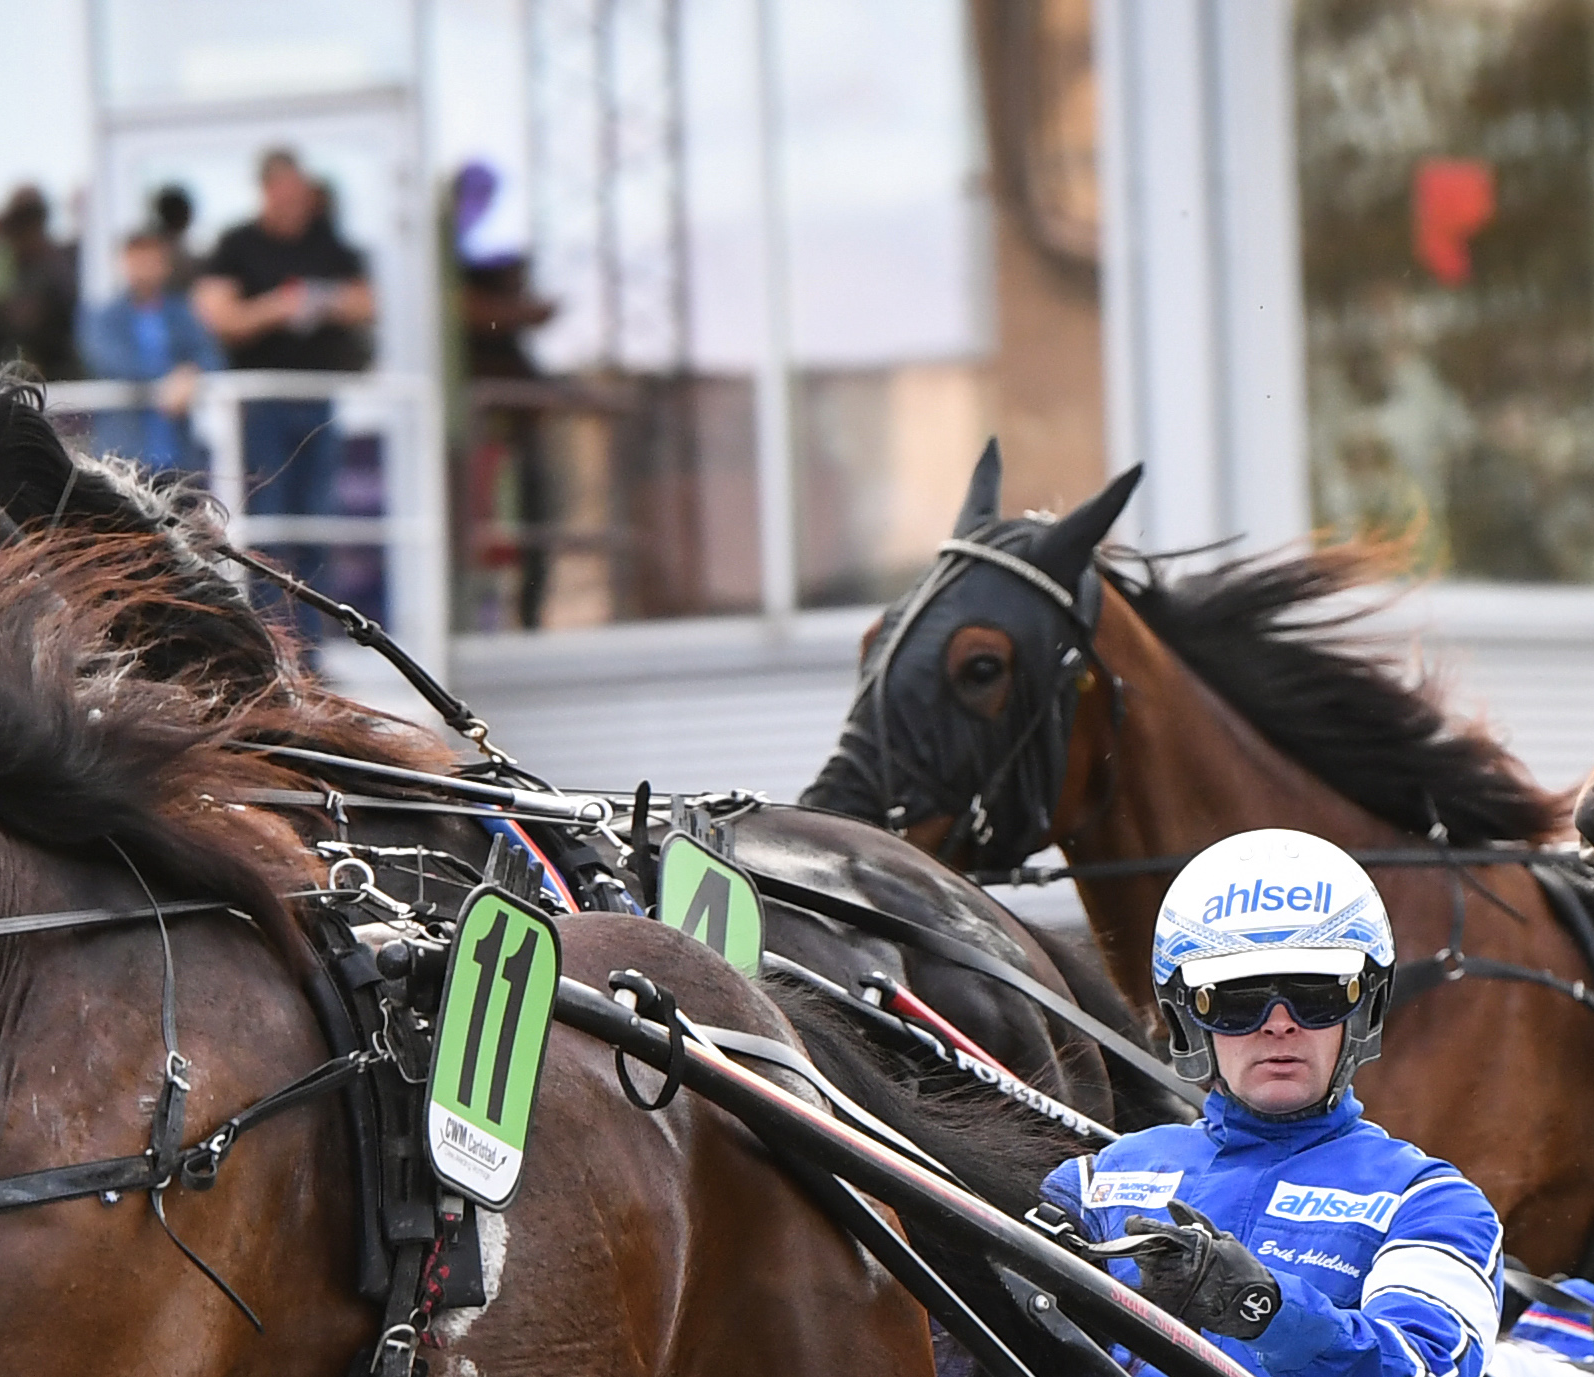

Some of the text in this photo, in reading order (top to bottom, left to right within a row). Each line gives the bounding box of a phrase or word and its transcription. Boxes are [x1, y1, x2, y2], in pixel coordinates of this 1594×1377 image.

[1202, 879, 1332, 924] ahlsell
[456, 909, 540, 1126] 11
[445, 1117, 468, 1148] CWM
[1275, 1191, 1394, 1224] ahlsell
[1257, 1240, 1361, 1278] Erik Adielsson
